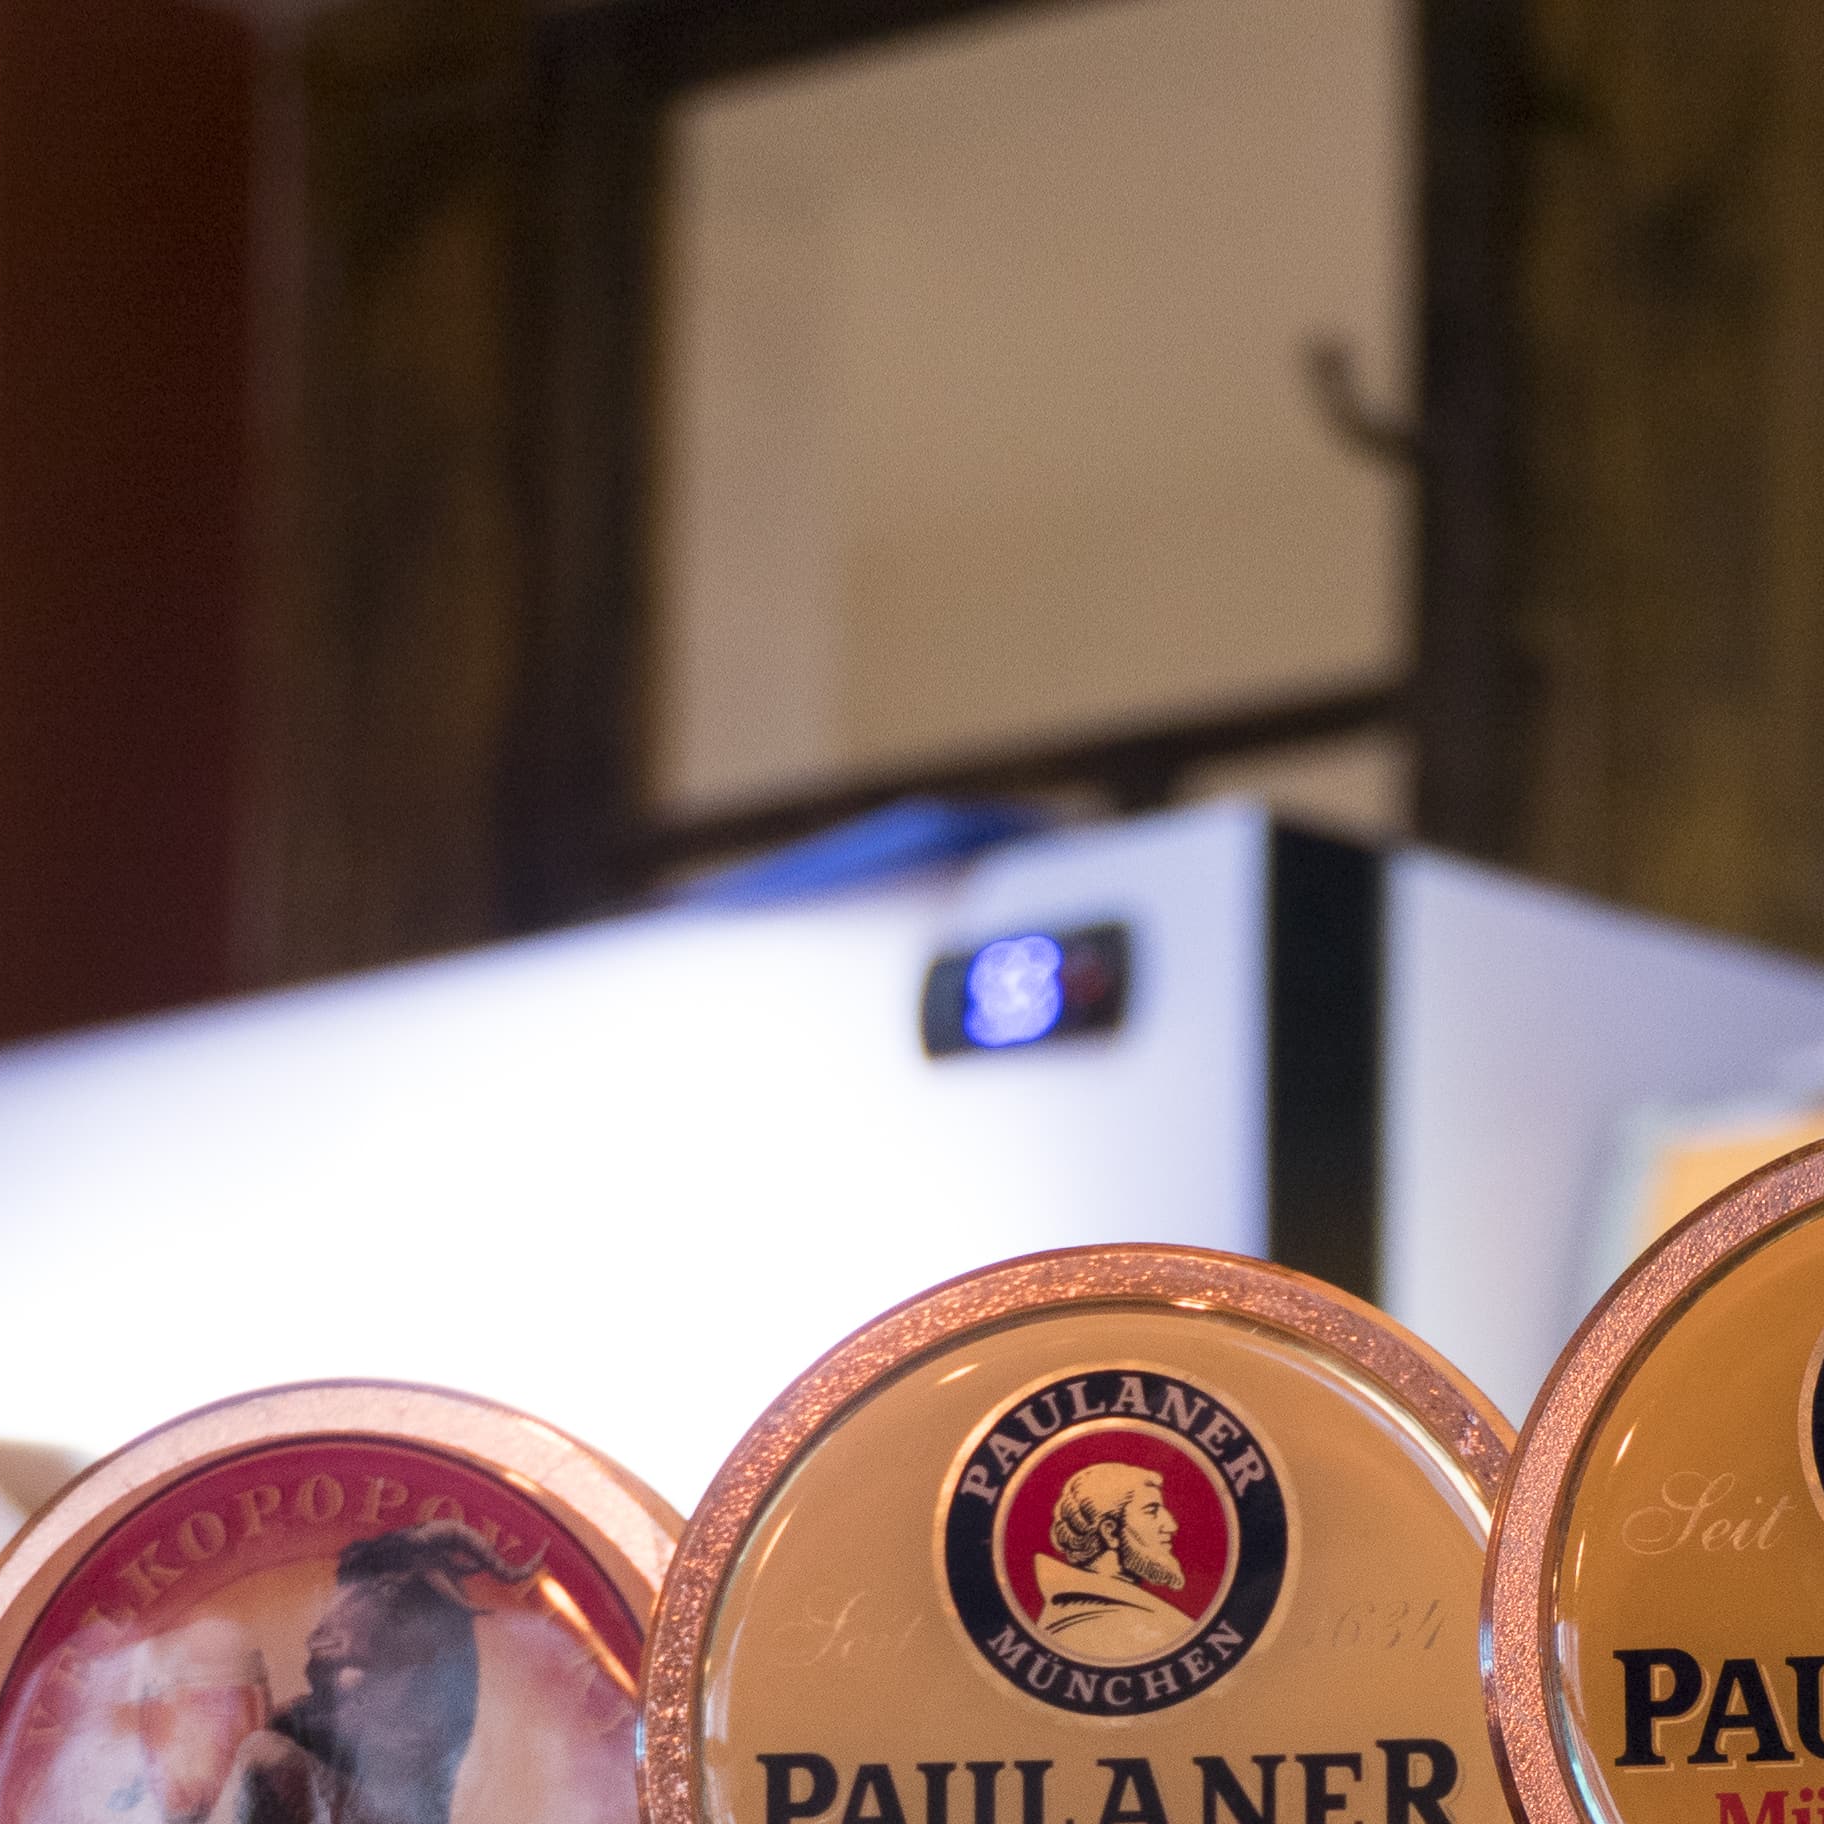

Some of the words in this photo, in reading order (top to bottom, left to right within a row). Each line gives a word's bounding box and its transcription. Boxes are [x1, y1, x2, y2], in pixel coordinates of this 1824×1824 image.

[961, 1376, 1270, 1506] PAULANER
[1622, 1470, 1796, 1556] Seit
[986, 1619, 1246, 1709] MÜNCHEN
